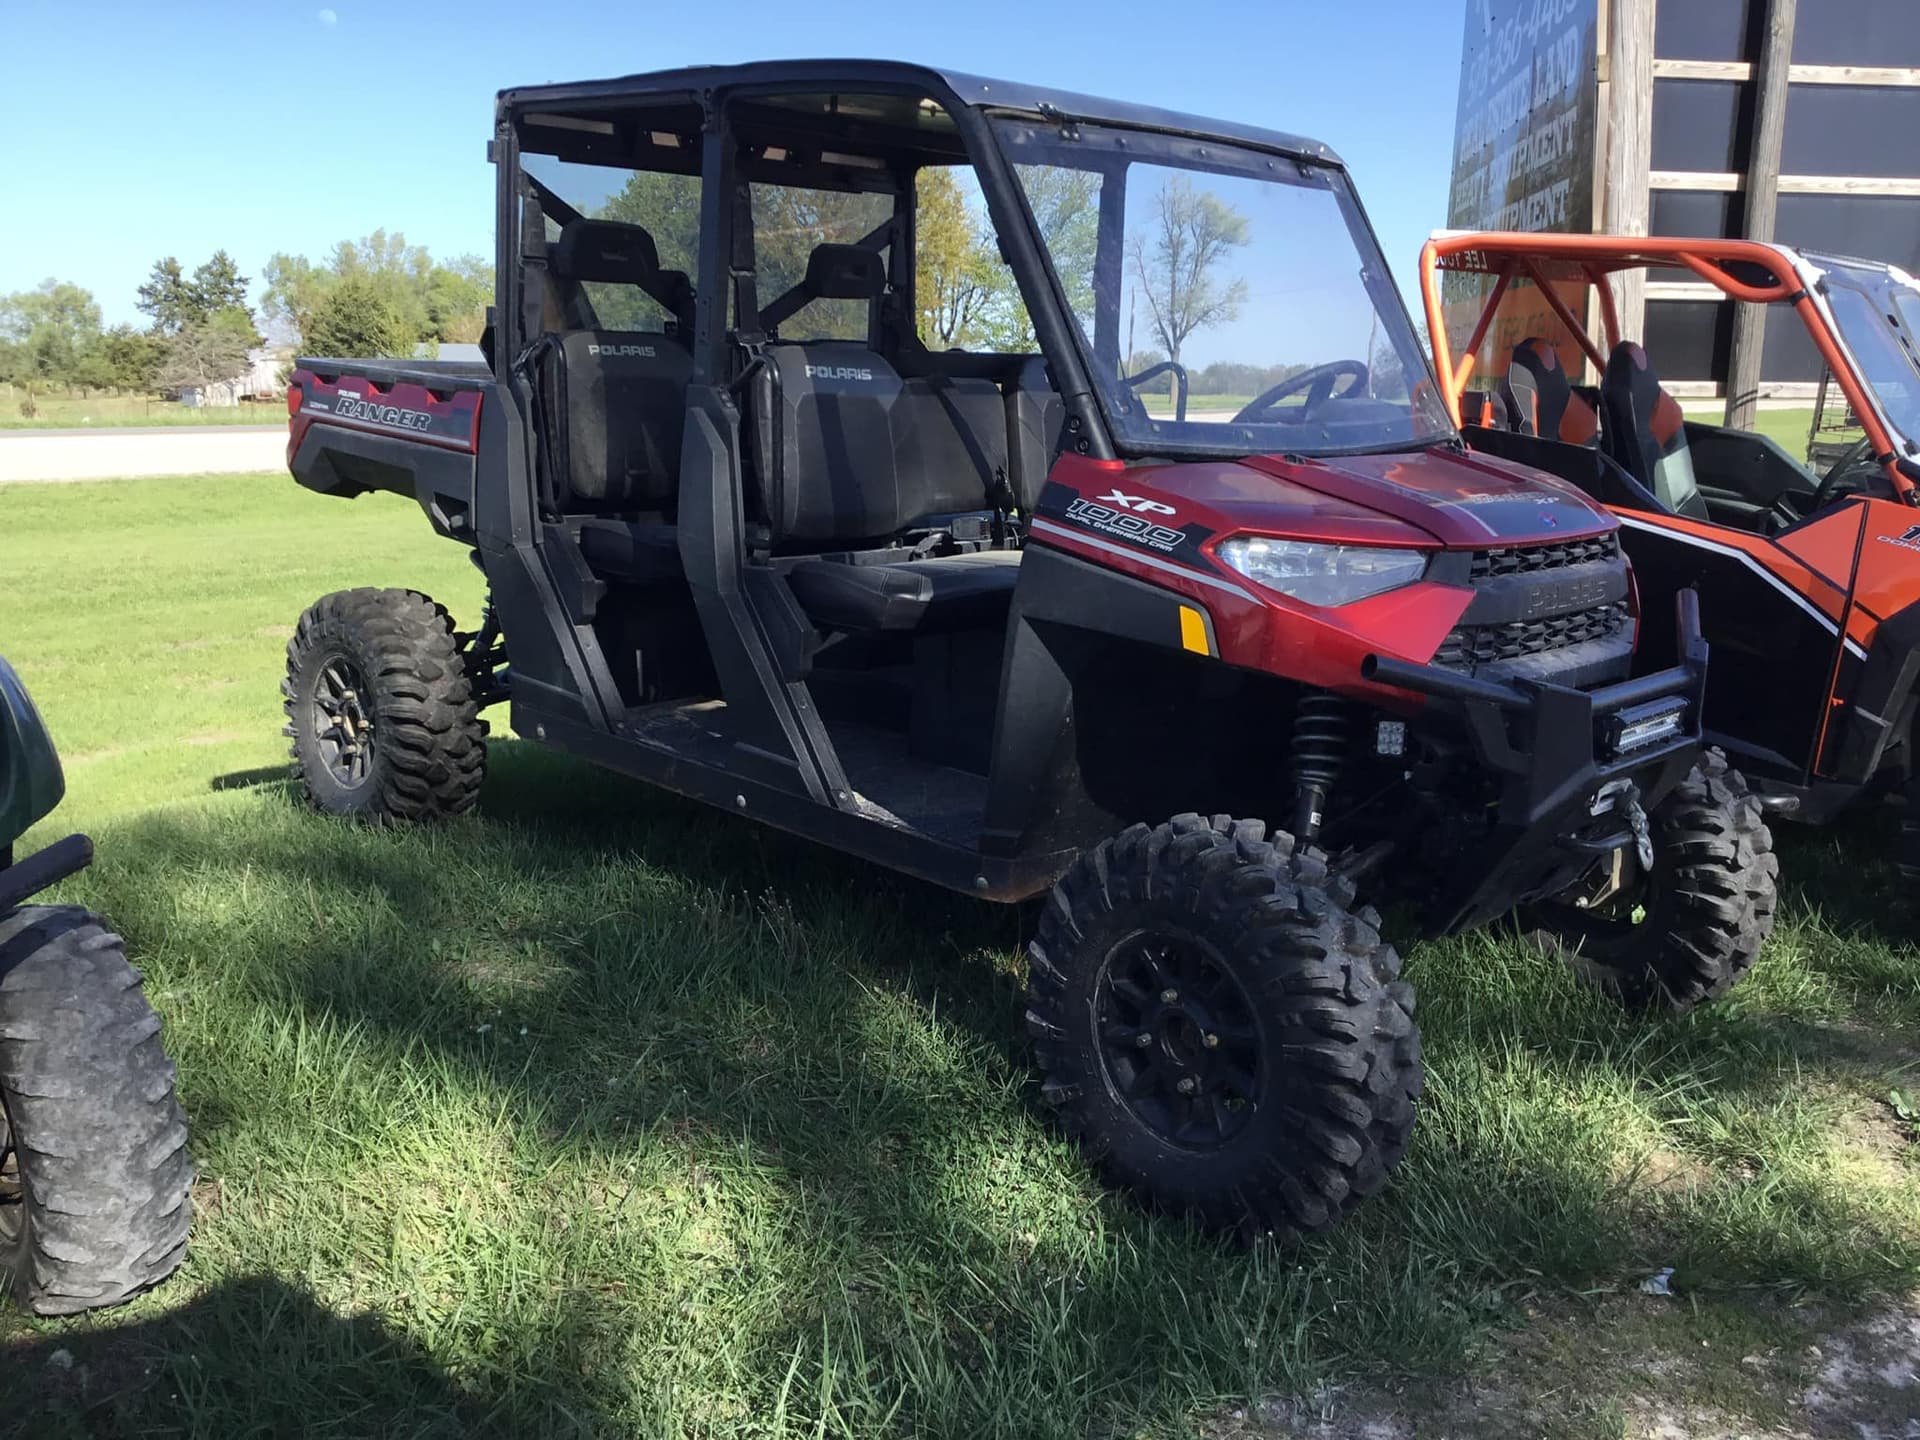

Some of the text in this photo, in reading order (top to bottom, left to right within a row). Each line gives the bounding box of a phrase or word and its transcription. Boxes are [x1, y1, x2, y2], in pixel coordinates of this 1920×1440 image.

[1534, 24, 1579, 109] LAND
[1488, 106, 1578, 193] EQUIPMENT
[588, 344, 656, 357] POLARIS
[805, 365, 873, 380] POLARIS
[335, 398, 432, 431] RANGER
[1095, 488, 1177, 515] XP
[1065, 512, 1174, 552] DUAL OVERHEAD CAM
[1066, 498, 1186, 547] 1000
